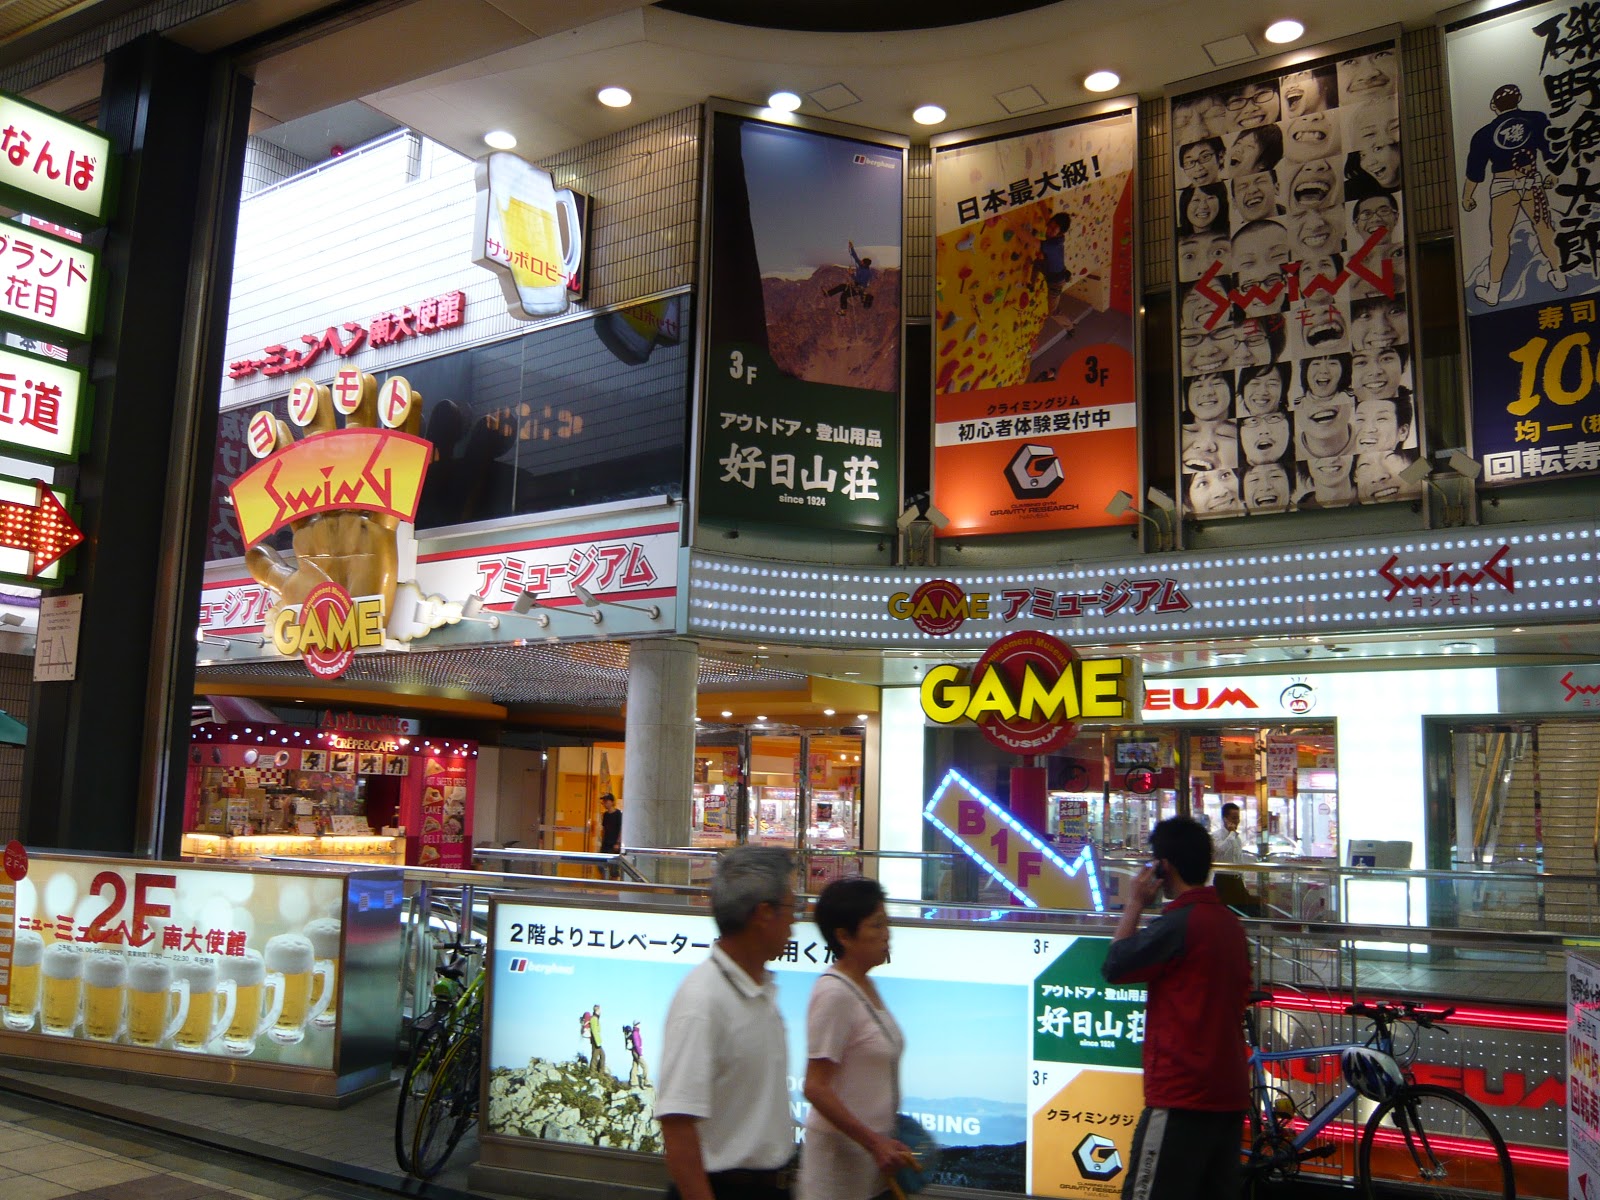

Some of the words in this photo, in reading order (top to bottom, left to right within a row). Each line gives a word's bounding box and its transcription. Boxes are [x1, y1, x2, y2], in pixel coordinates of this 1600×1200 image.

[1, 125, 97, 191] なんば
[957, 155, 1101, 224] 日本最大級!
[486, 238, 581, 291] サッポロビール
[5, 275, 57, 317] 花月
[1538, 300, 1596, 330] 寿司
[729, 350, 757, 385] 3F
[1085, 355, 1110, 387] 3F
[1507, 332, 1600, 416] 10
[987, 396, 1080, 416] クライミングジム
[720, 412, 882, 448] アウトドア・登山用品
[958, 409, 1111, 442] 初心者体験受付中
[719, 443, 880, 501] 好日山荘
[779, 493, 804, 504] since
[806, 496, 826, 506] 1924
[990, 508, 1027, 516] GRAVITY
[1029, 504, 1079, 513] RESEARCH
[477, 543, 658, 597] アミュージアム
[887, 591, 990, 620] GAME
[1001, 578, 1193, 623] アミュージアム
[1412, 593, 1479, 608] ヨシモト
[274, 598, 384, 656] GAME
[920, 657, 1123, 724] GAME
[320, 709, 410, 733] Aphrodite
[89, 871, 177, 945] 2F
[162, 924, 248, 957] 南大使館
[1034, 939, 1050, 954] 3F
[1033, 1070, 1048, 1086] 3F
